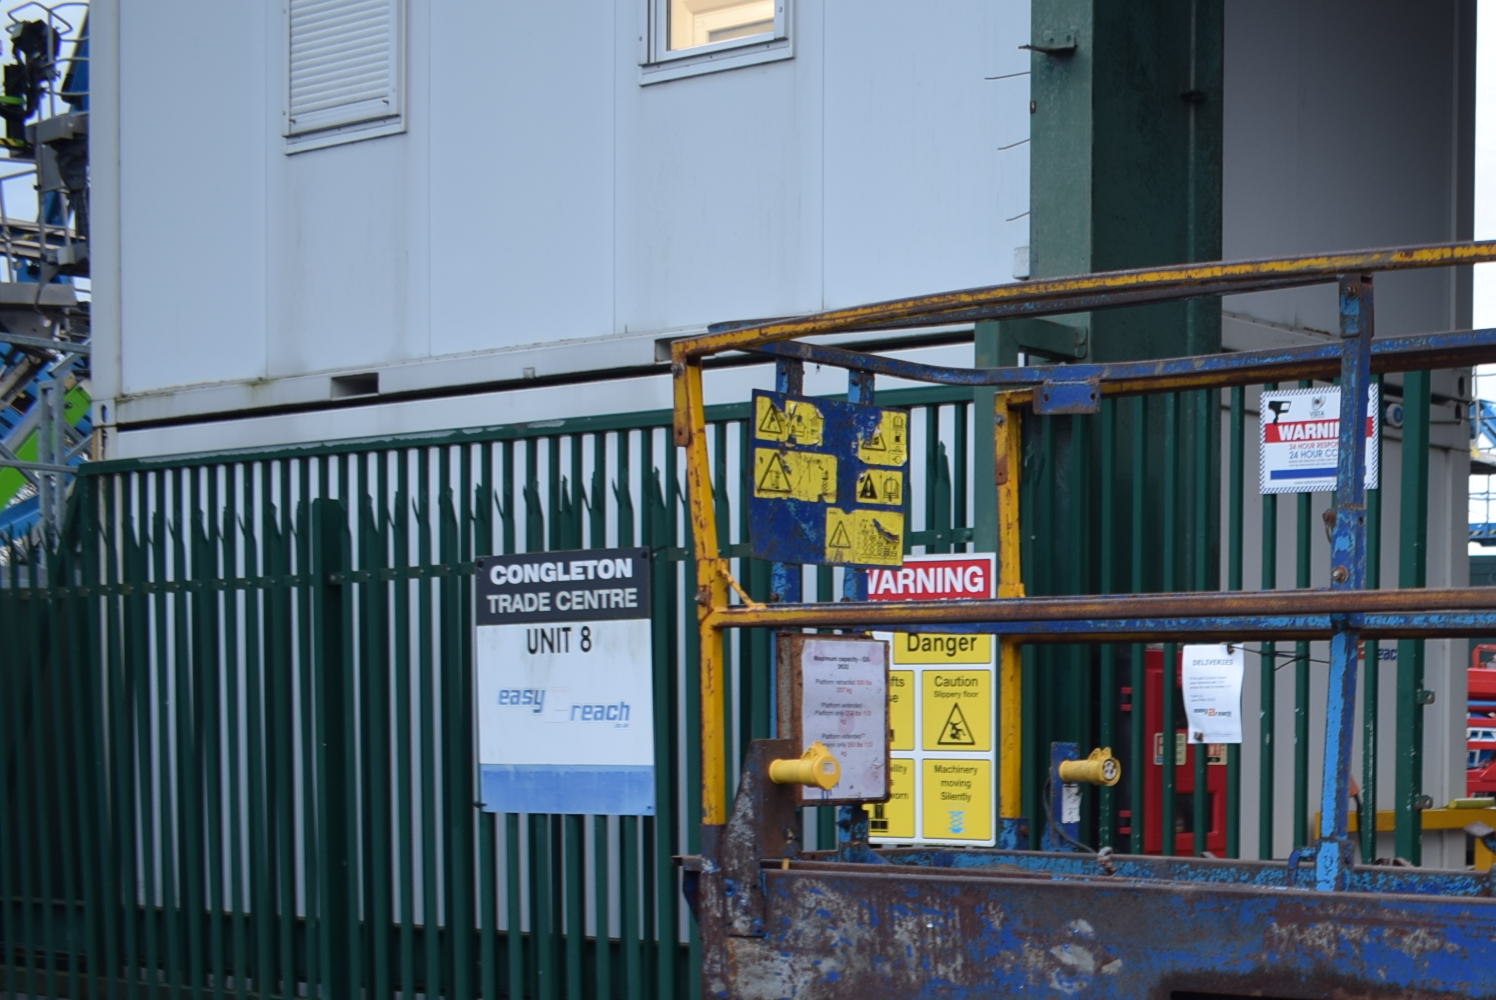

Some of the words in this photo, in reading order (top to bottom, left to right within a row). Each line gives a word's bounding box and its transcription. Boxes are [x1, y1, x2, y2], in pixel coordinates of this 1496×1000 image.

[1278, 421, 1340, 441] WARNI
[1300, 449, 1323, 458] HOUR
[490, 558, 633, 585] CONGLETON
[486, 592, 551, 613] TRADE
[556, 588, 638, 611] CENTRE
[526, 626, 572, 654] UNIT
[580, 626, 592, 652] 8
[907, 633, 977, 657] Danger
[934, 675, 978, 687] Caution
[498, 689, 545, 713] easy
[934, 690, 961, 699] Slippery
[963, 690, 978, 698] floor
[570, 701, 630, 721] reach
[934, 764, 978, 776] Machinery
[940, 779, 972, 789] moving
[940, 791, 972, 802] Silently
